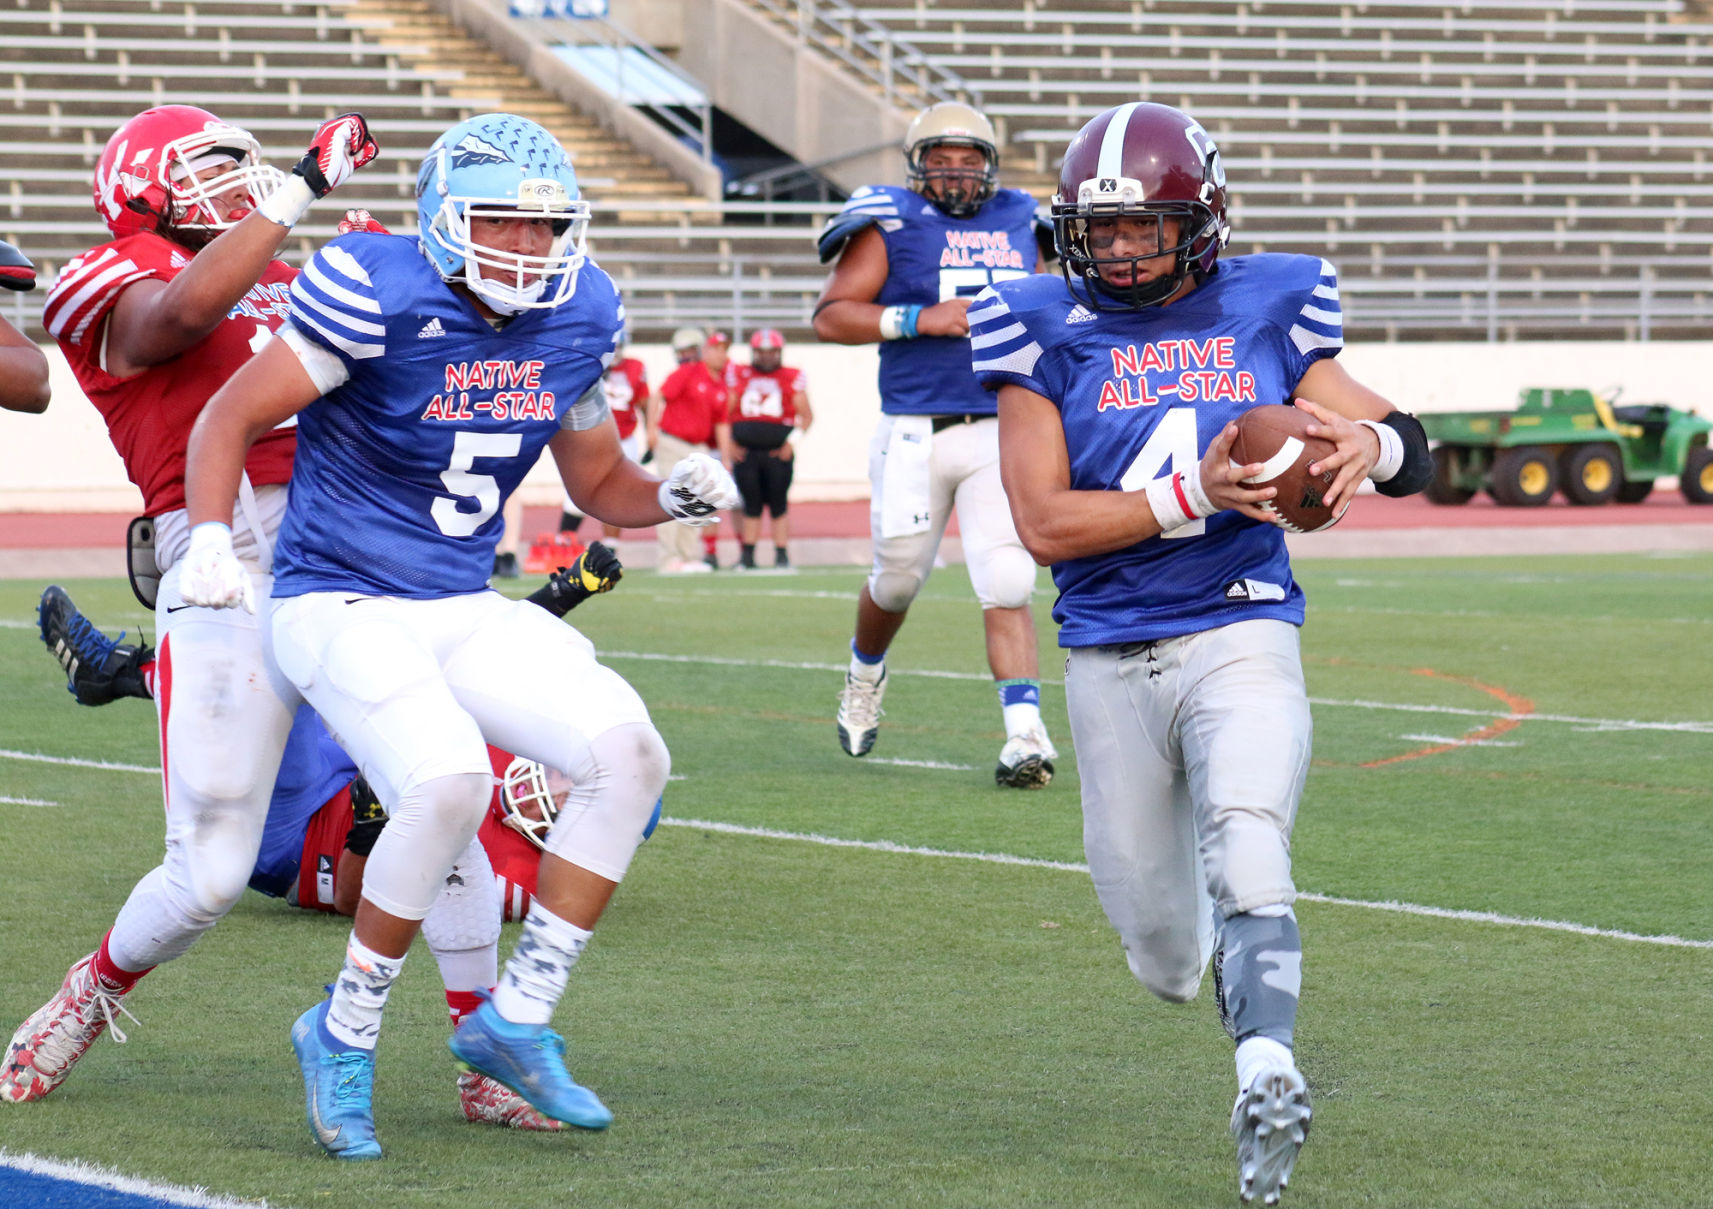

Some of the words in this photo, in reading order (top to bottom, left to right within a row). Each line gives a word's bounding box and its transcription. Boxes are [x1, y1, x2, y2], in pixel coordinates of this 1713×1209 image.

[945, 230, 1011, 250] NATIVE
[940, 247, 1024, 269] ALL-STAR
[1066, 313, 1098, 324] adidas
[1111, 337, 1236, 378] NATIVE
[445, 360, 545, 392] NATIVE
[421, 392, 556, 421] ALL-STAR
[1097, 371, 1256, 412] ALL-STAR
[430, 431, 523, 537] 5
[1120, 408, 1206, 539] 4
[1252, 585, 1260, 594] L
